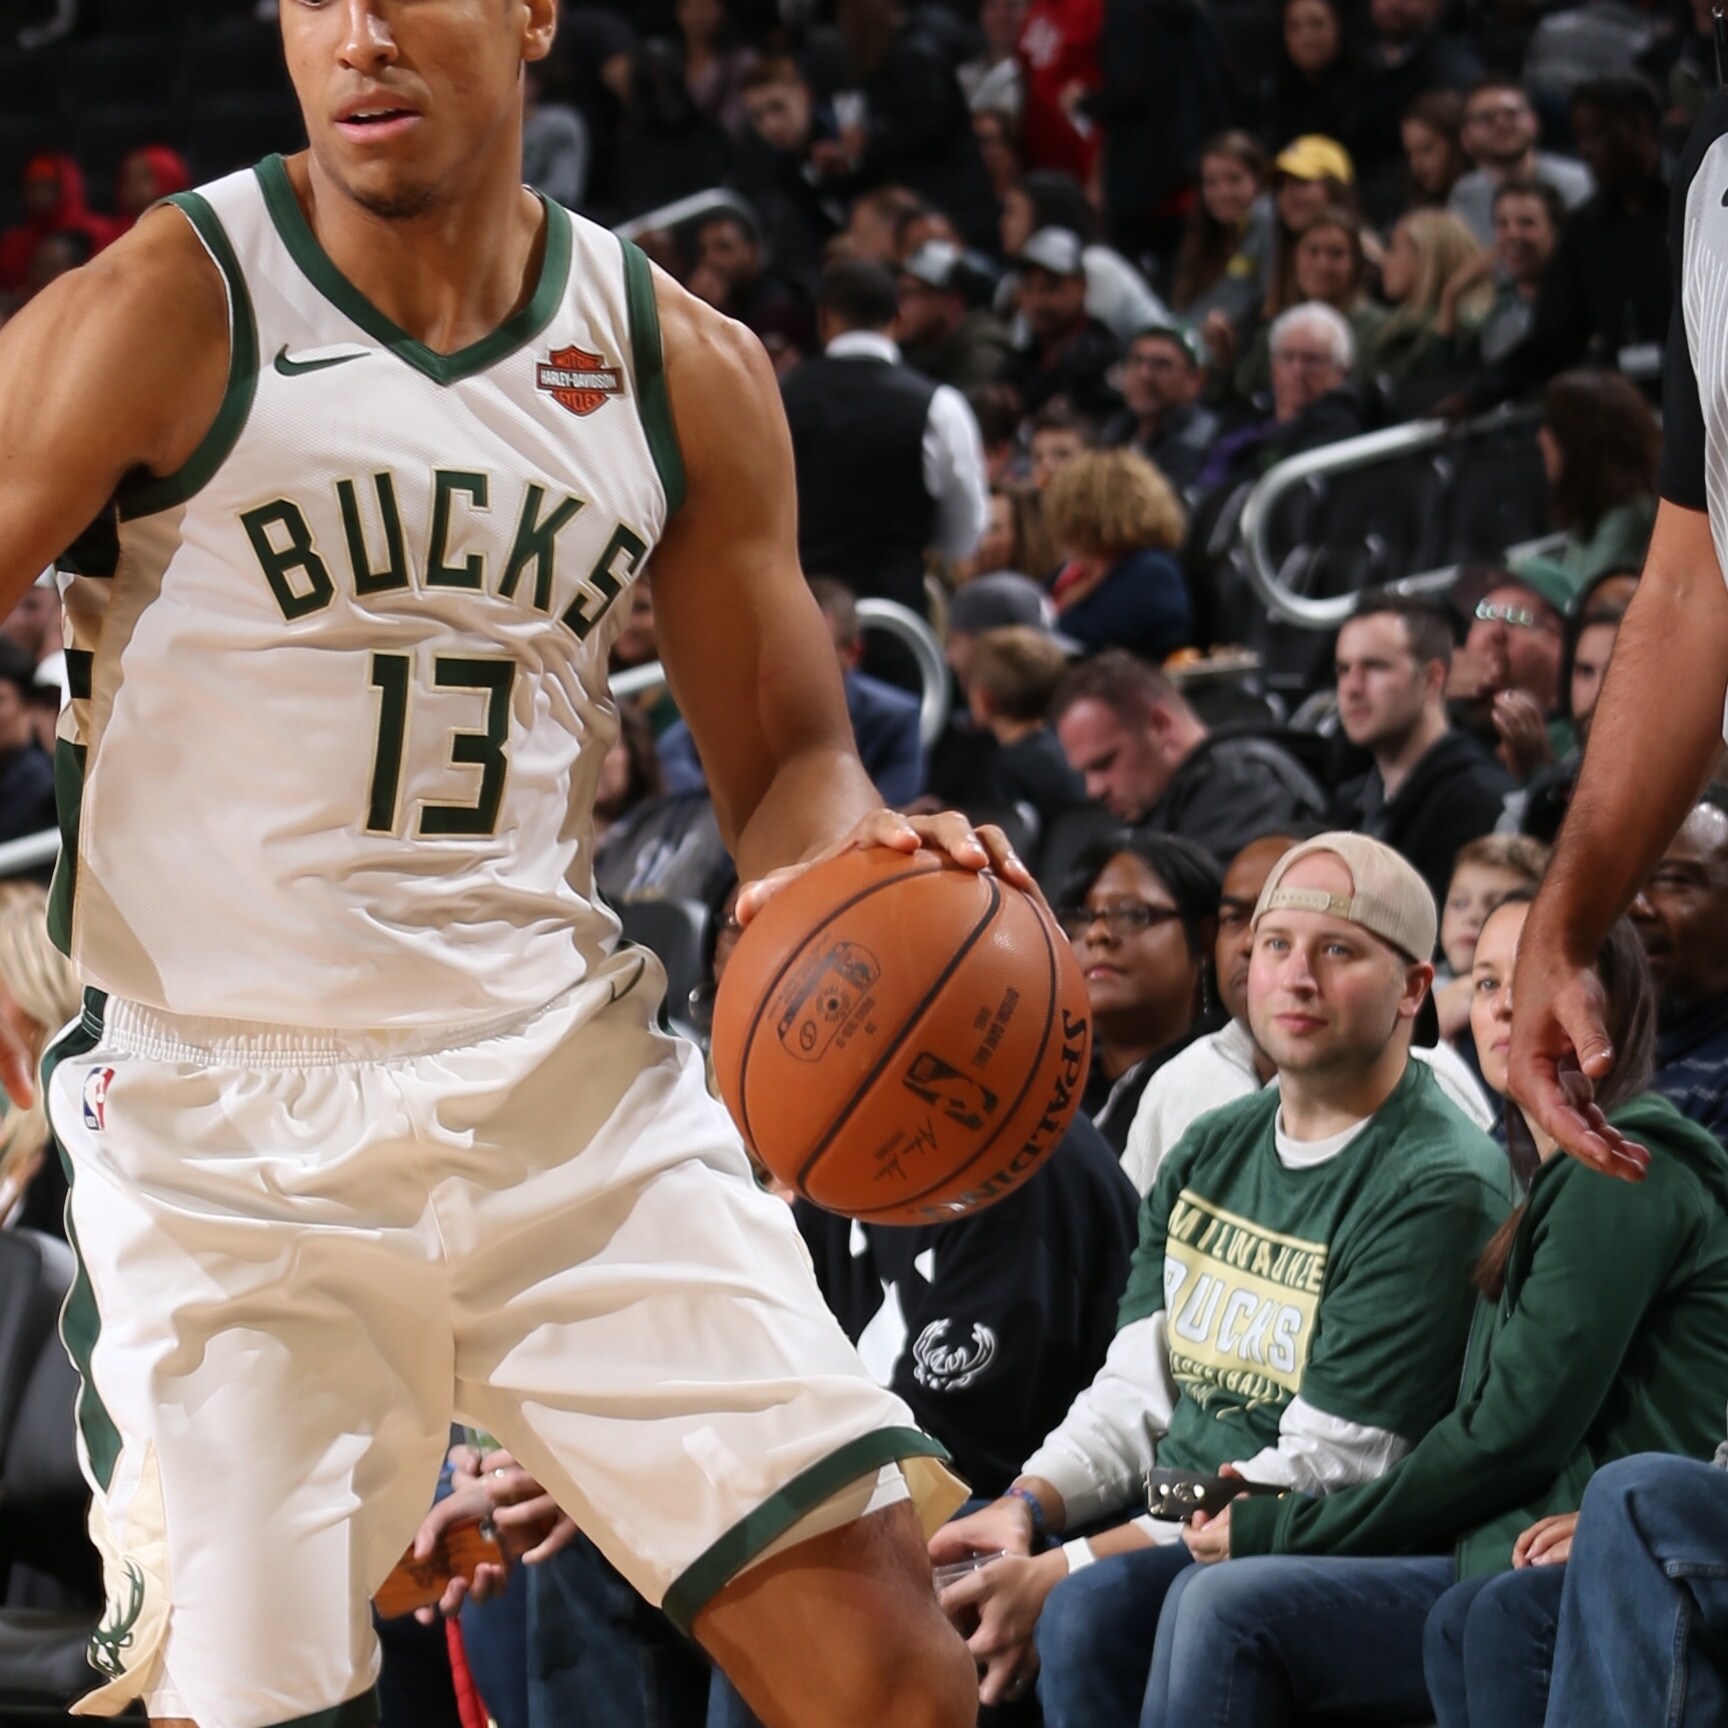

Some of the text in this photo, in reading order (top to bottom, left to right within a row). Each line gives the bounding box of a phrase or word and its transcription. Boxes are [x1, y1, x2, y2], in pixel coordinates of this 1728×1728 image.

[540, 369, 618, 389] HARLEY-DAVIDSON
[238, 468, 655, 642] BUCKS
[361, 649, 520, 839] 13
[919, 1008, 1087, 1217] SPALDING
[1164, 1256, 1303, 1374] BUCKS
